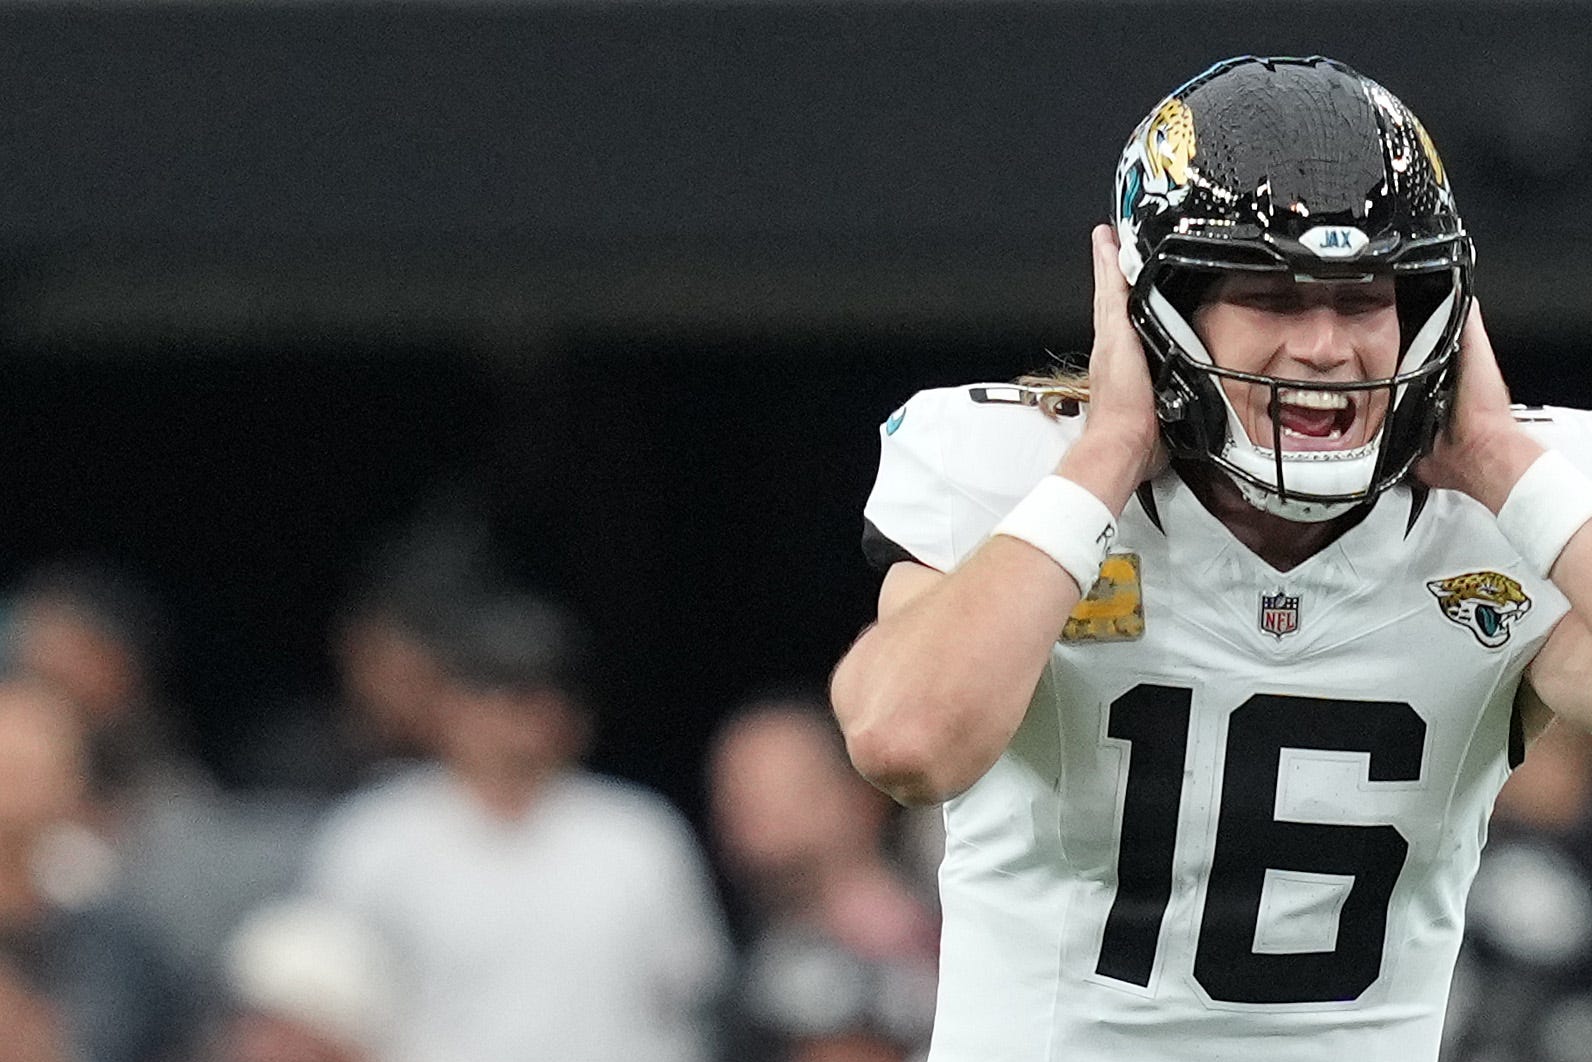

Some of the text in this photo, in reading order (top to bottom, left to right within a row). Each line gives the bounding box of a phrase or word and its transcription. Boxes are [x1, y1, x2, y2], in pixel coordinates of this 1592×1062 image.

[1319, 229, 1352, 249] JAX
[1265, 610, 1294, 632] NFL
[1095, 683, 1427, 1004] 16
